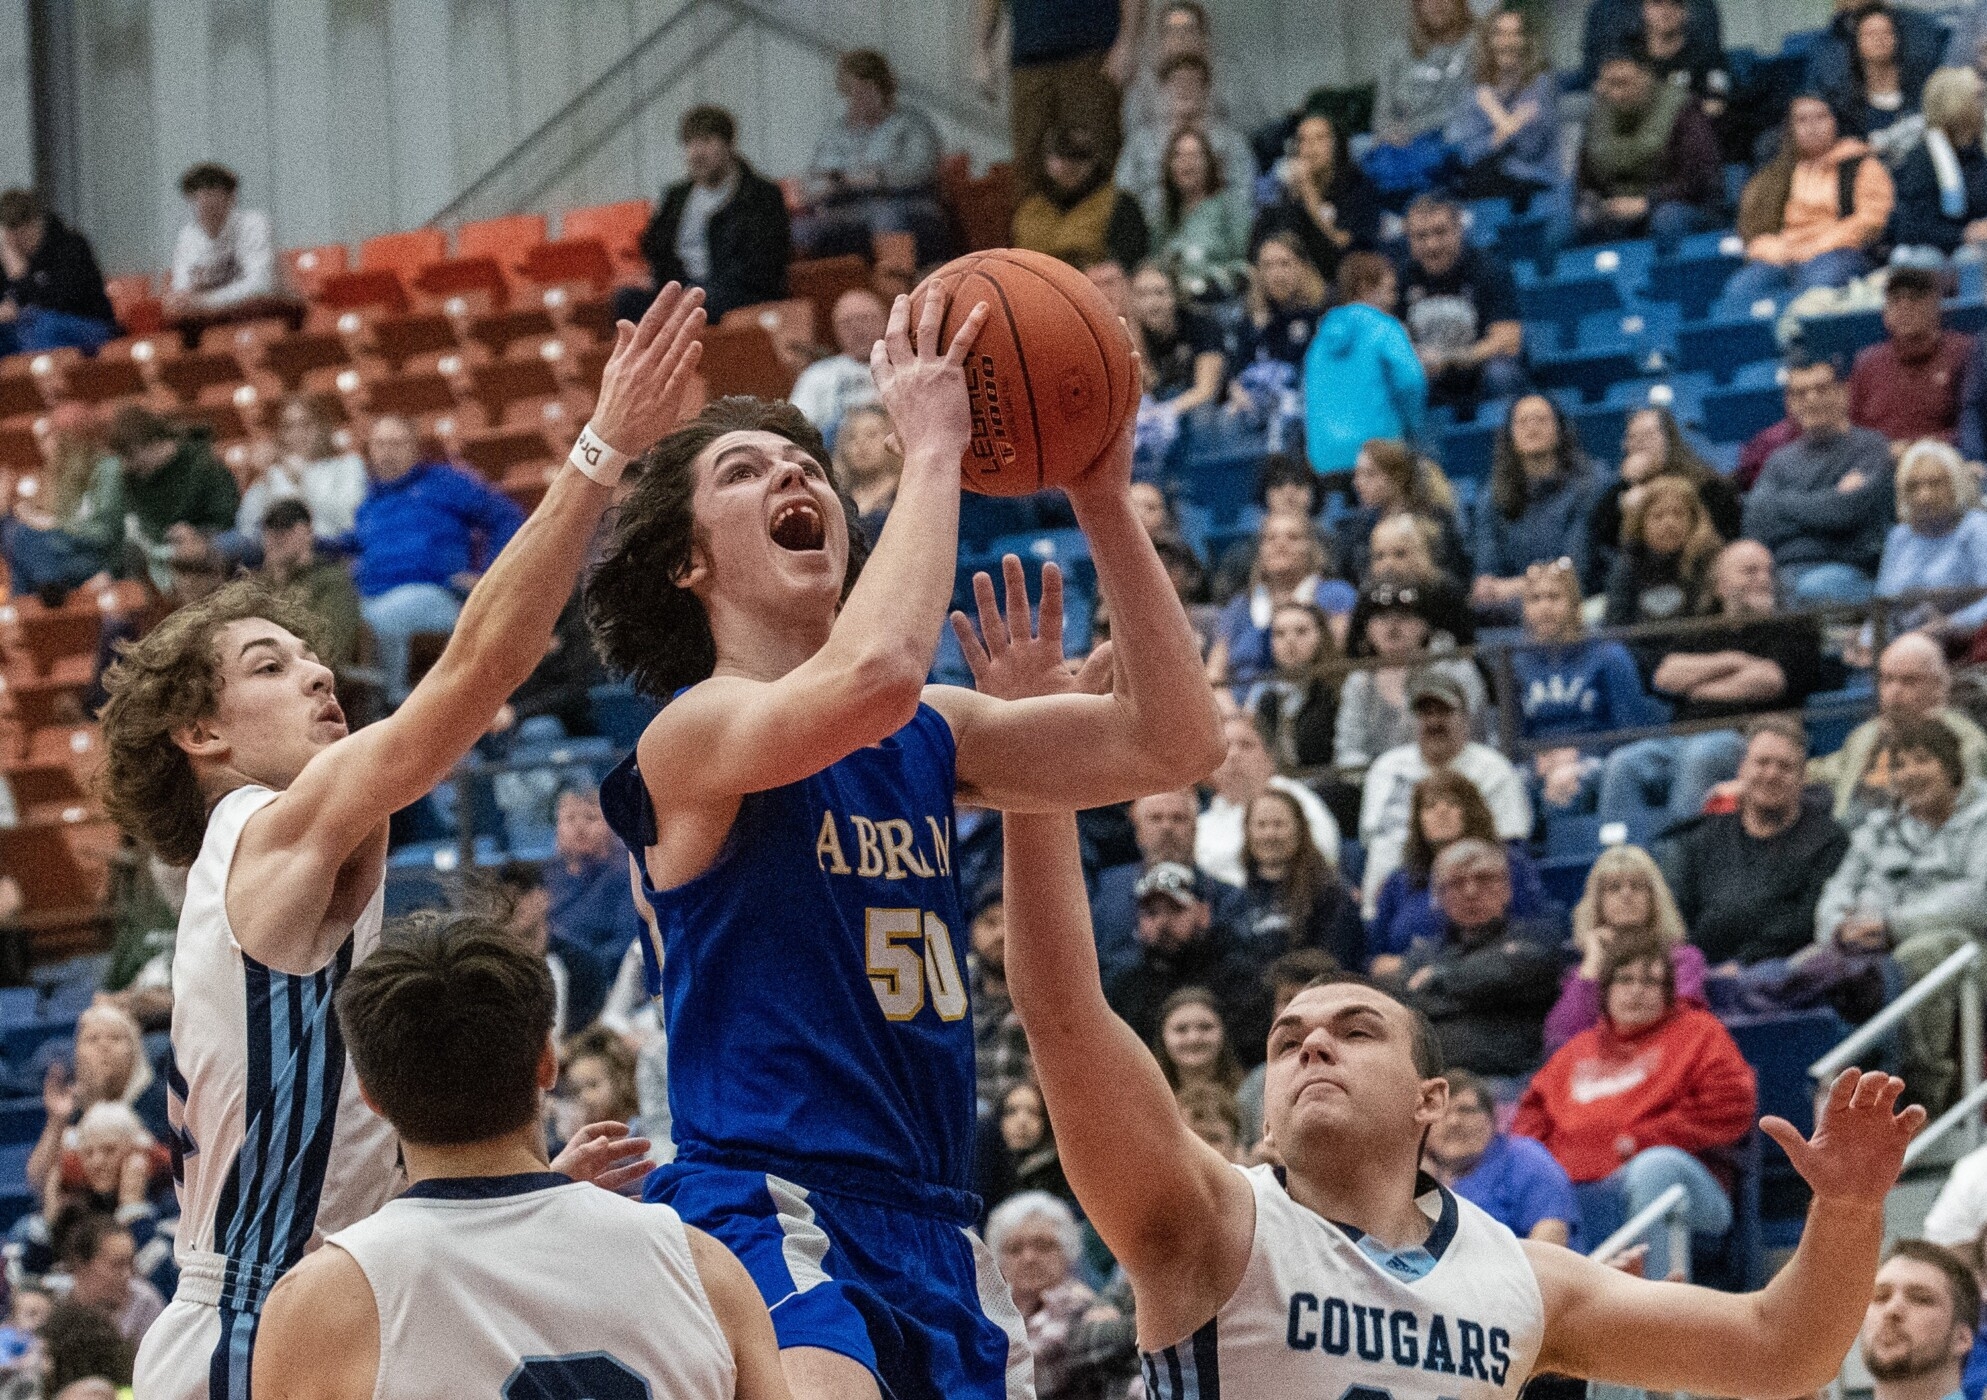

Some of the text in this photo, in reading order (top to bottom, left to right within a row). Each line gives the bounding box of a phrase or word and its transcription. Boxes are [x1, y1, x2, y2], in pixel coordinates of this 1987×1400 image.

[981, 355, 1007, 437] 1000
[865, 907, 968, 1022] 50
[1286, 1291, 1511, 1387] COUGARS
